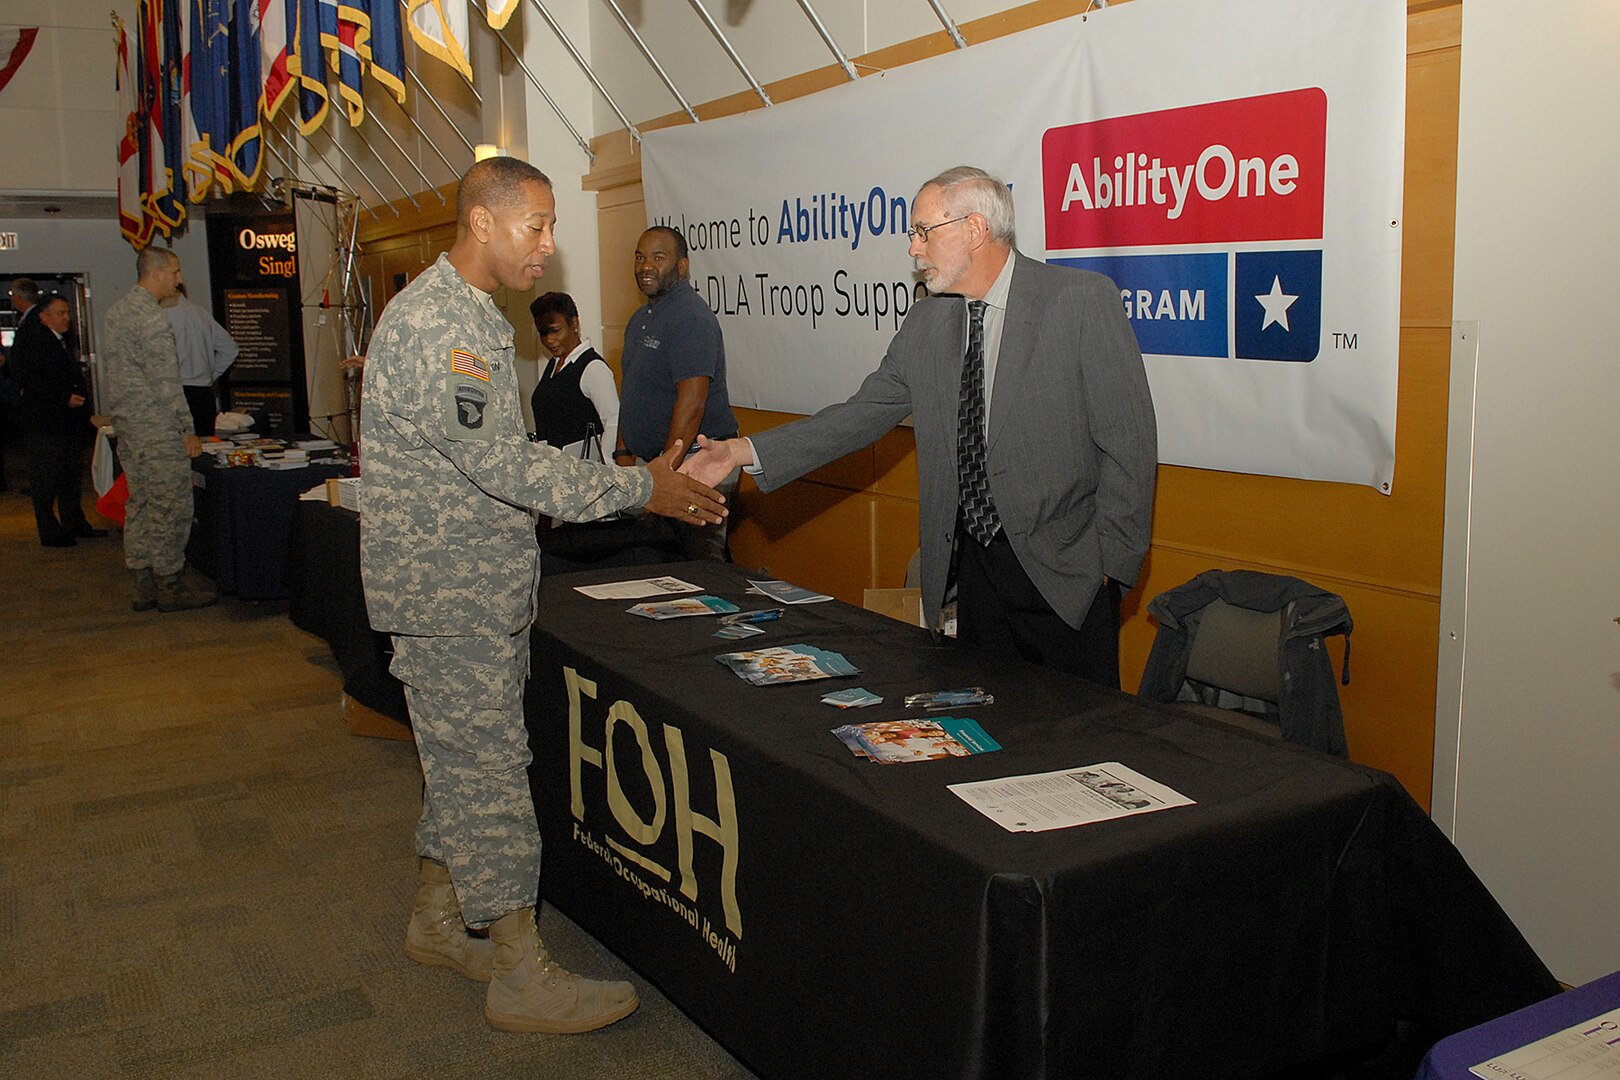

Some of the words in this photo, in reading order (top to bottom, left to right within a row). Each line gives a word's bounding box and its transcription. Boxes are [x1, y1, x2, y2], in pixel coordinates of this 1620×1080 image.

[1061, 144, 1299, 220] AbilityOne
[1, 234, 15, 248] XIT
[239, 228, 296, 252] Osweg
[655, 214, 741, 250] lcome
[748, 208, 769, 246] to
[777, 186, 916, 250] AbilityOn
[259, 255, 296, 278] Singl
[707, 274, 751, 316] DLA
[755, 273, 825, 329] Troop
[834, 270, 929, 330] Suppo
[1120, 289, 1205, 321] GRAM
[1332, 332, 1358, 350] TM
[563, 666, 742, 940] FOH
[613, 856, 699, 930] Occupational
[702, 916, 736, 973] Health
